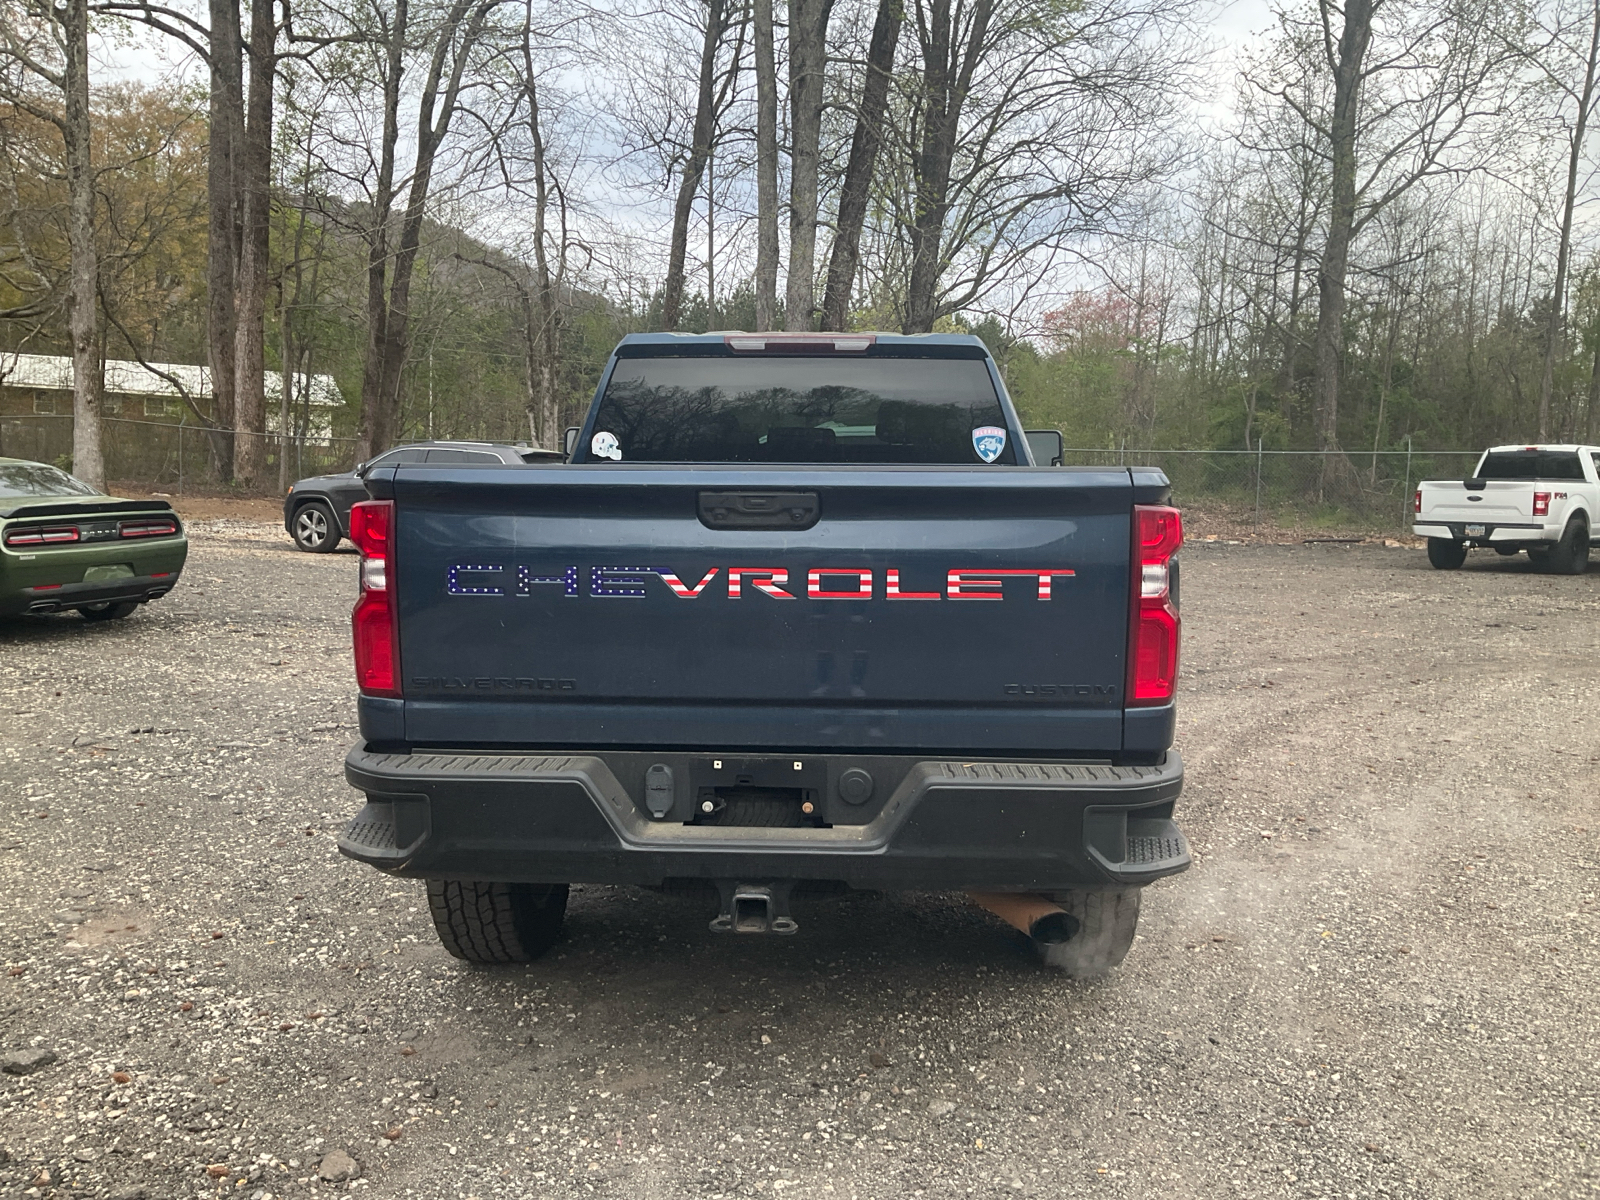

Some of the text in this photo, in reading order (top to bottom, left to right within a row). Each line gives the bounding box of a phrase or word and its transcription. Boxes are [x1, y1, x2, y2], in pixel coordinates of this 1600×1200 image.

[446, 564, 1076, 601] CHEVROLET
[411, 676, 578, 690] SILVERADO
[1003, 683, 1117, 695] CUSTOM
